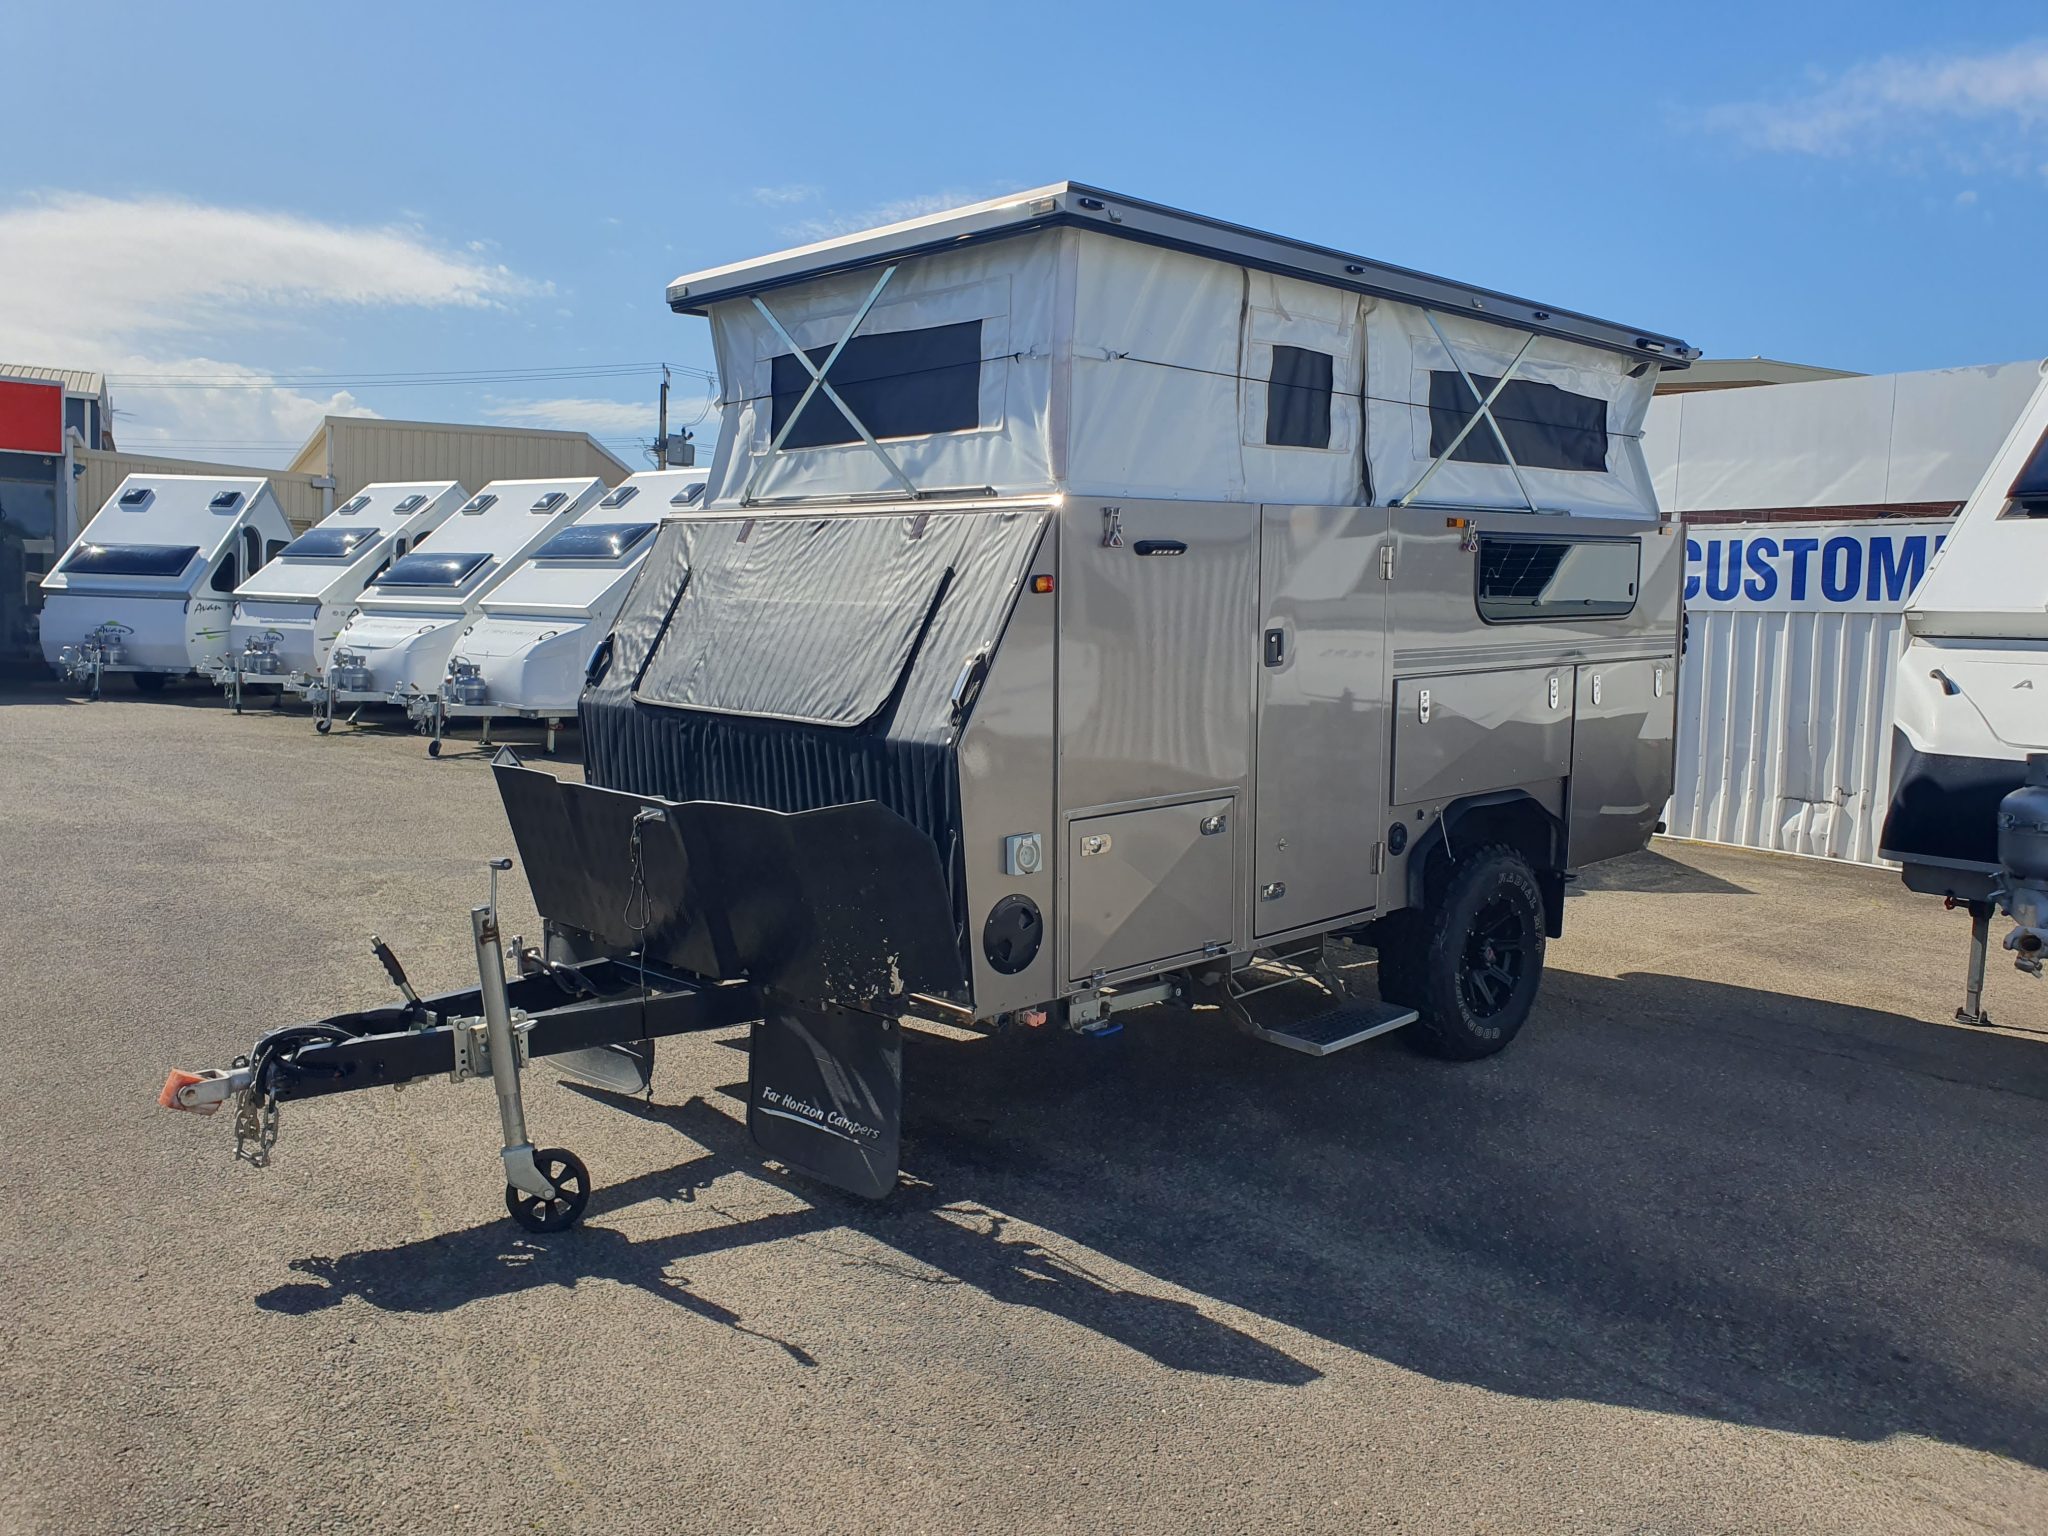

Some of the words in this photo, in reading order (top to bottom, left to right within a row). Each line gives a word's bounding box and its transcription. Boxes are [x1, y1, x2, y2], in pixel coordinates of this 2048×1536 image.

[194, 603, 222, 615] Avan
[762, 1086, 781, 1103] Far
[782, 1095, 824, 1121] Horizon
[827, 1111, 881, 1139] Campers
